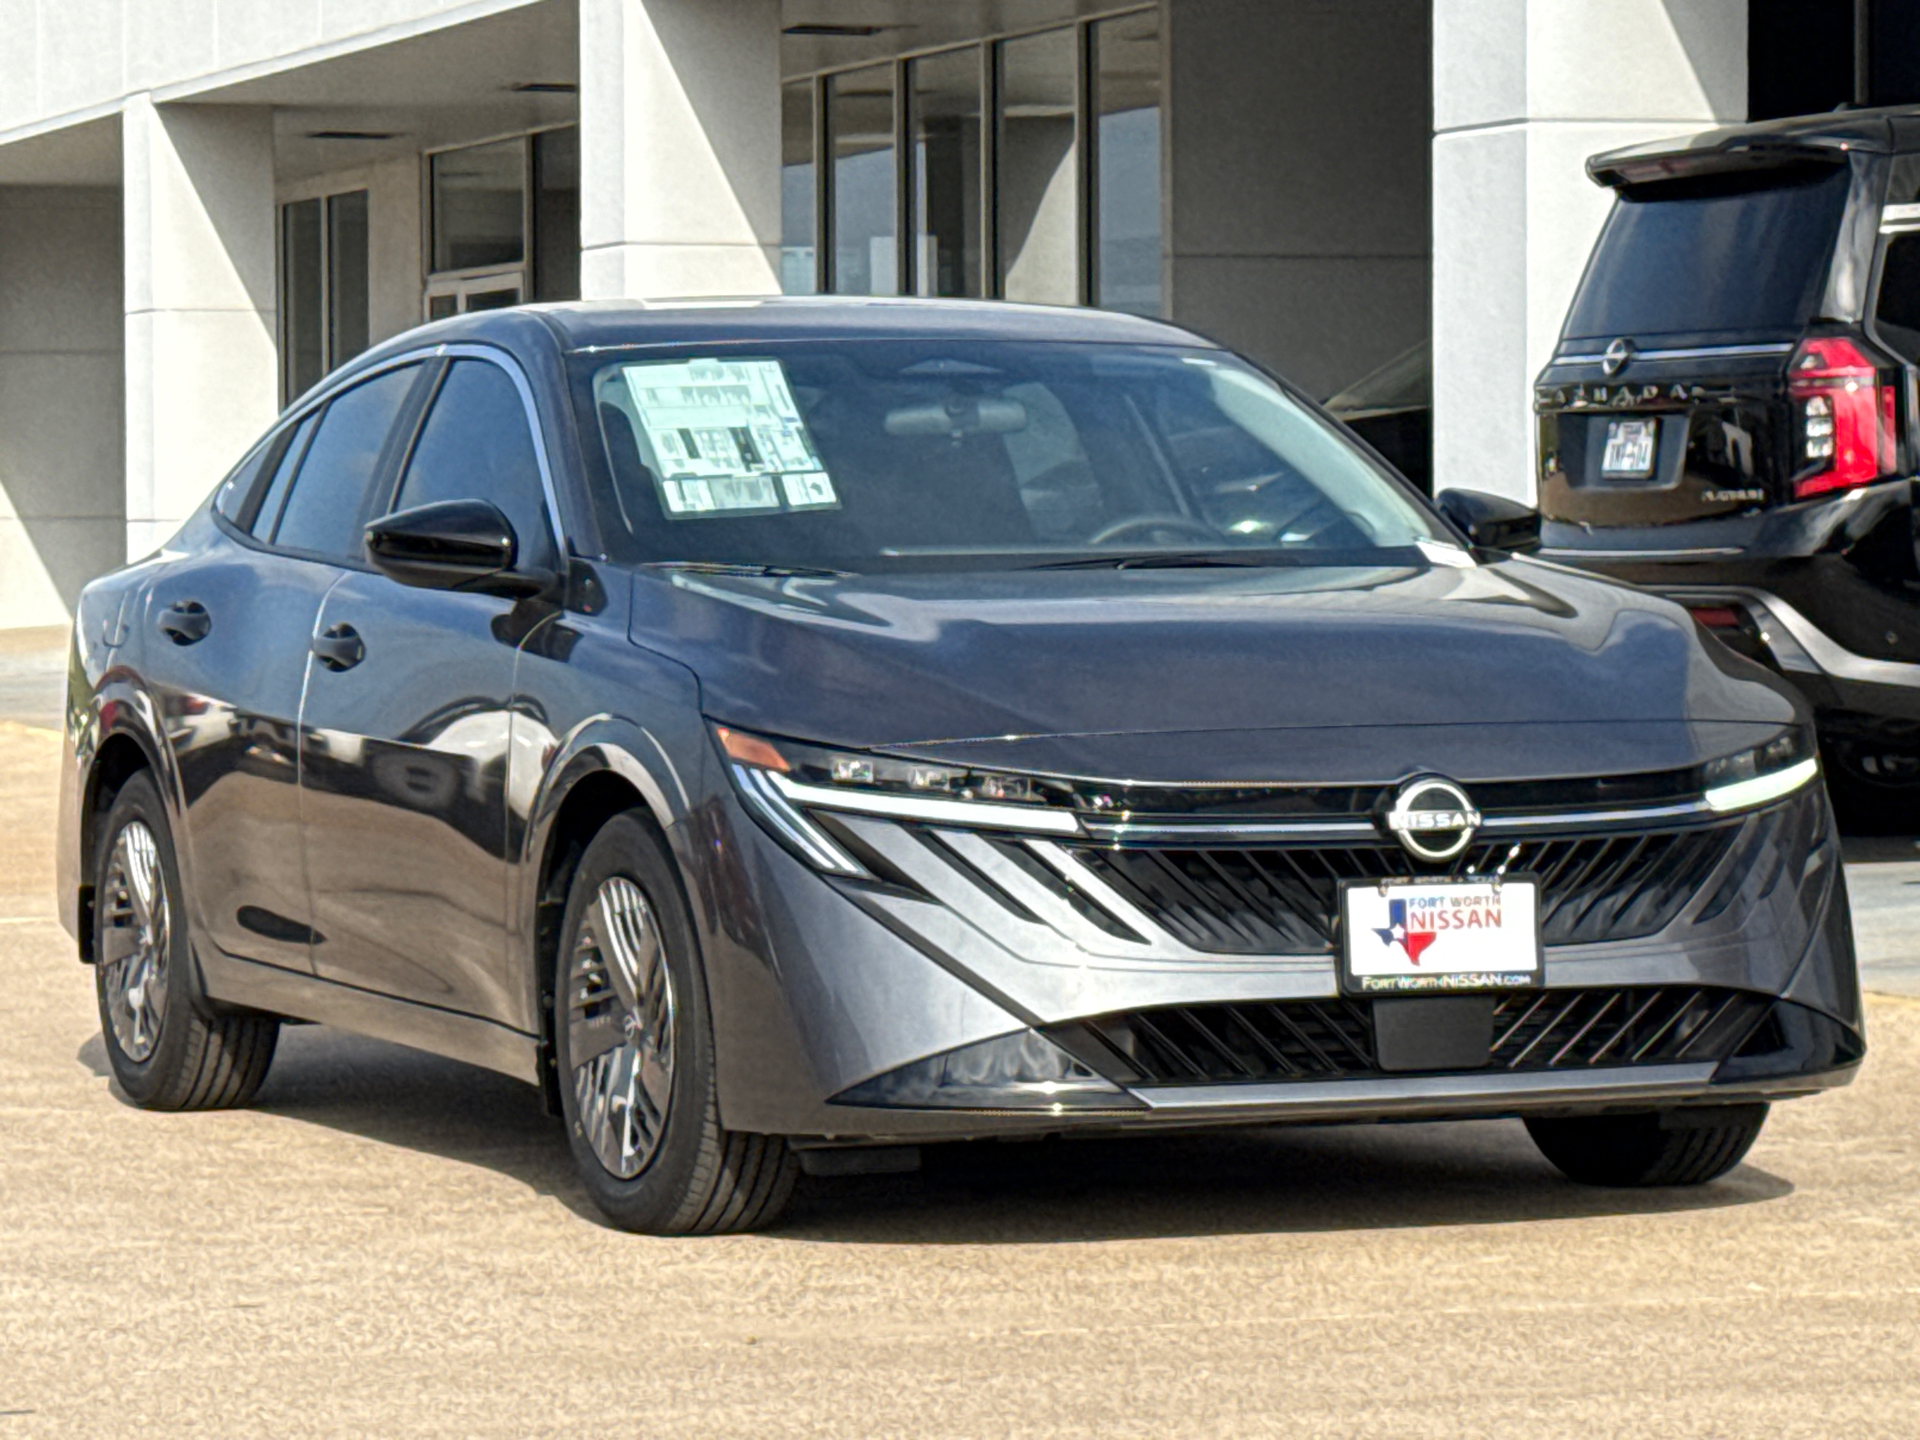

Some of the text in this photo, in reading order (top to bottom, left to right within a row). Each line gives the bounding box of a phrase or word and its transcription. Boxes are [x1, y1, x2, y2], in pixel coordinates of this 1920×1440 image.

[1391, 811, 1481, 828] NISSAN
[1409, 894, 1501, 909] FORT WORTH
[1410, 908, 1502, 930] NISSAN
